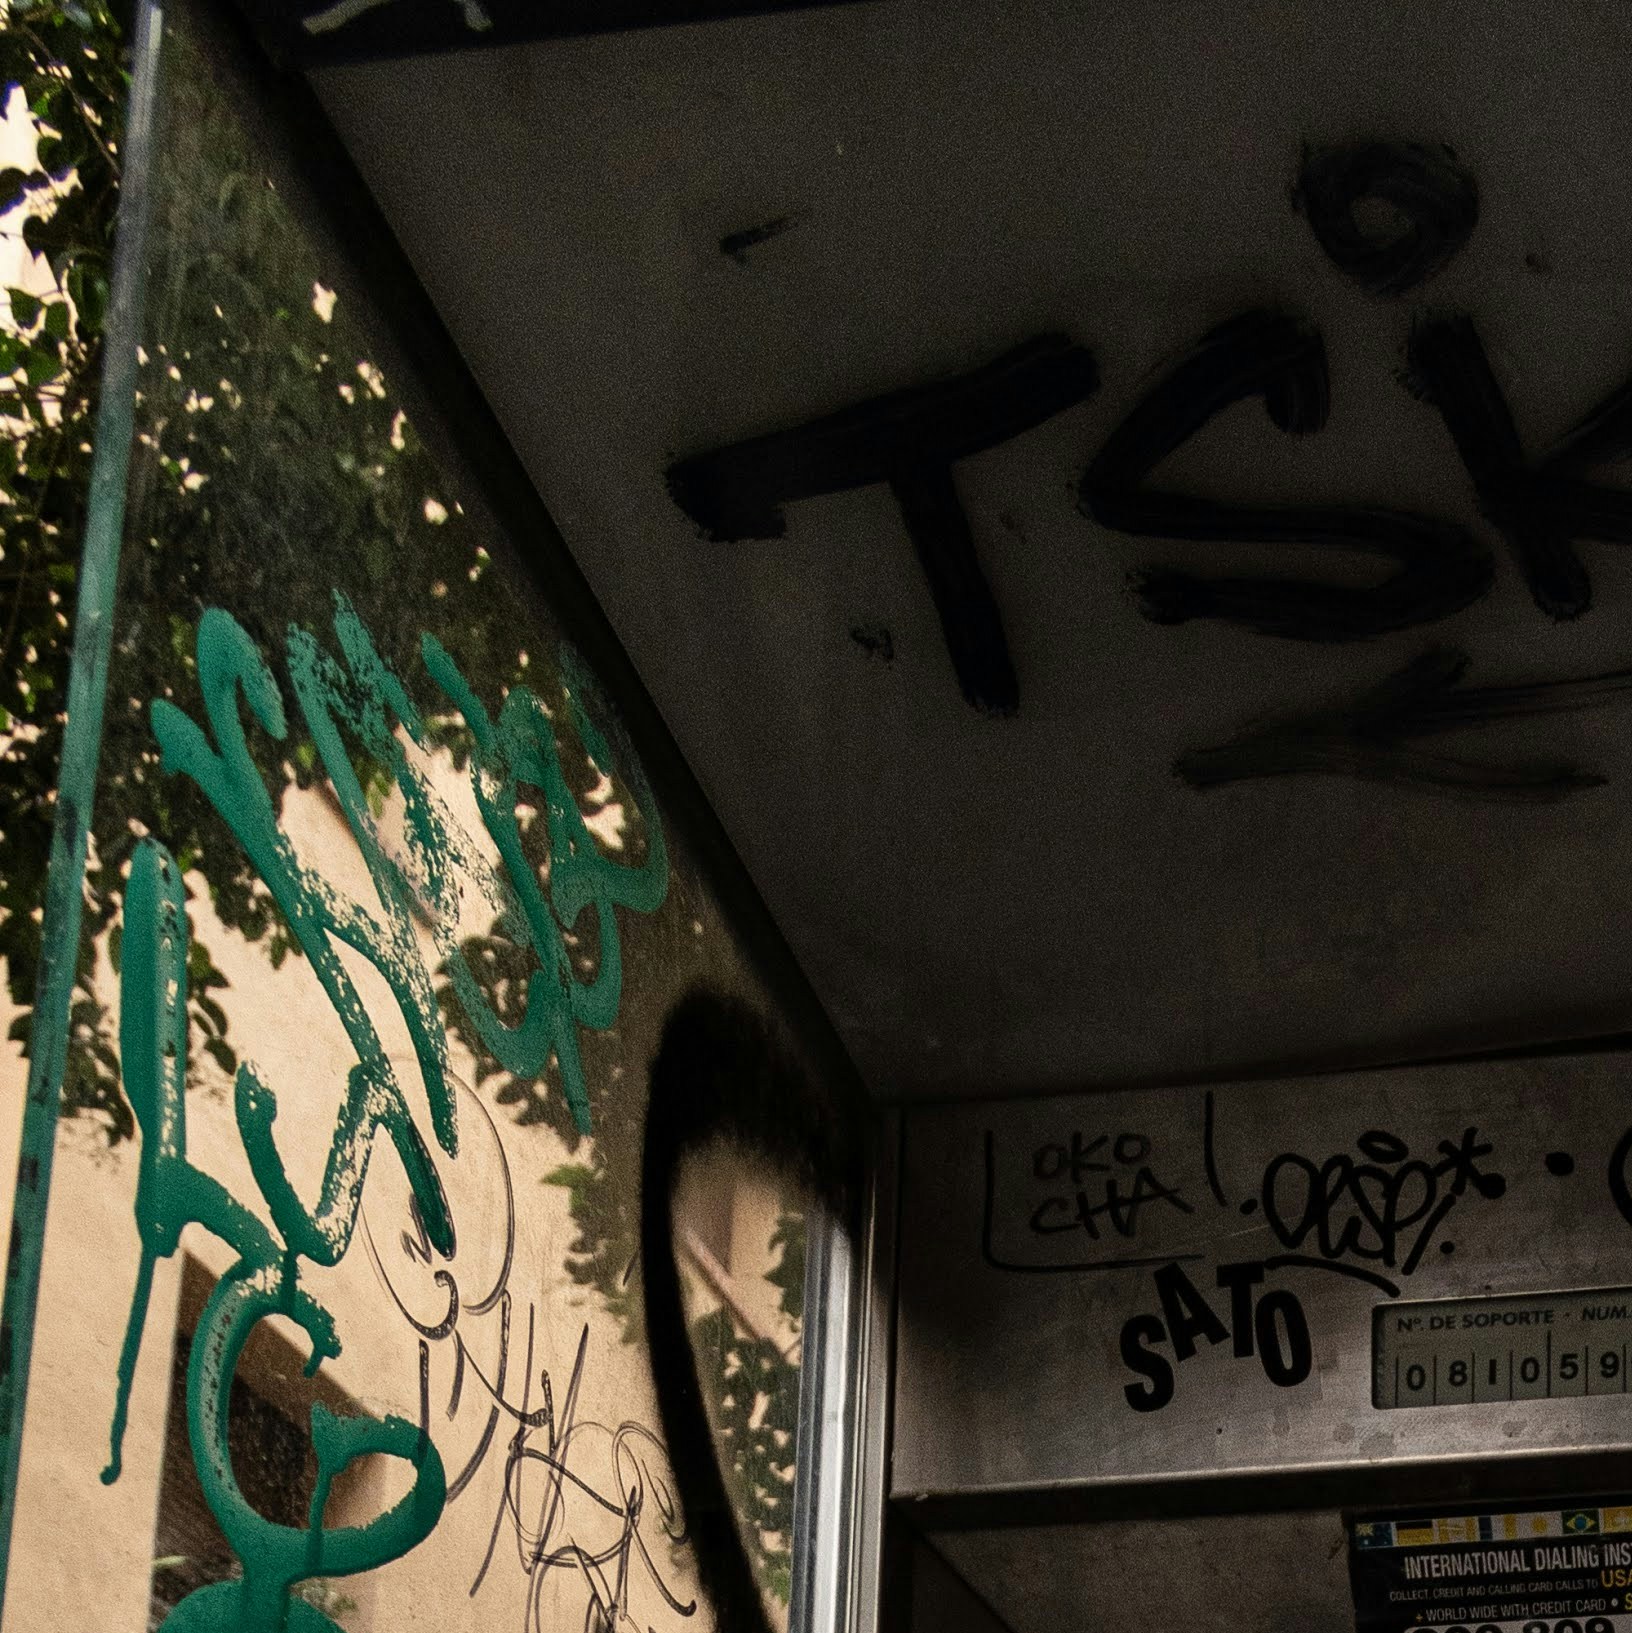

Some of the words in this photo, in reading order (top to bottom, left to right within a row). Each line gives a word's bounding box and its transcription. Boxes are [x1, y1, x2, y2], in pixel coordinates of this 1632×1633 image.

[1430, 1315, 1456, 1330] DE
[1461, 1310, 1555, 1329] SOPORTE
[1119, 1262, 1313, 1413] SATO
[1404, 1551, 1531, 1579] INTERNATIONAL
[1534, 1545, 1600, 1571] DIALING
[1432, 1585, 1464, 1599] CREDIT
[1466, 1584, 1486, 1597] AND
[1488, 1581, 1526, 1596] CALLING
[1528, 1580, 1553, 1593] CARD
[1556, 1578, 1583, 1592] CALLS
[1426, 1607, 1467, 1621] WORLD
[1470, 1605, 1498, 1619] WIDE
[1500, 1603, 1529, 1617] WITH
[1532, 1601, 1572, 1616] CREDIT
[1575, 1599, 1607, 1613] CARD
